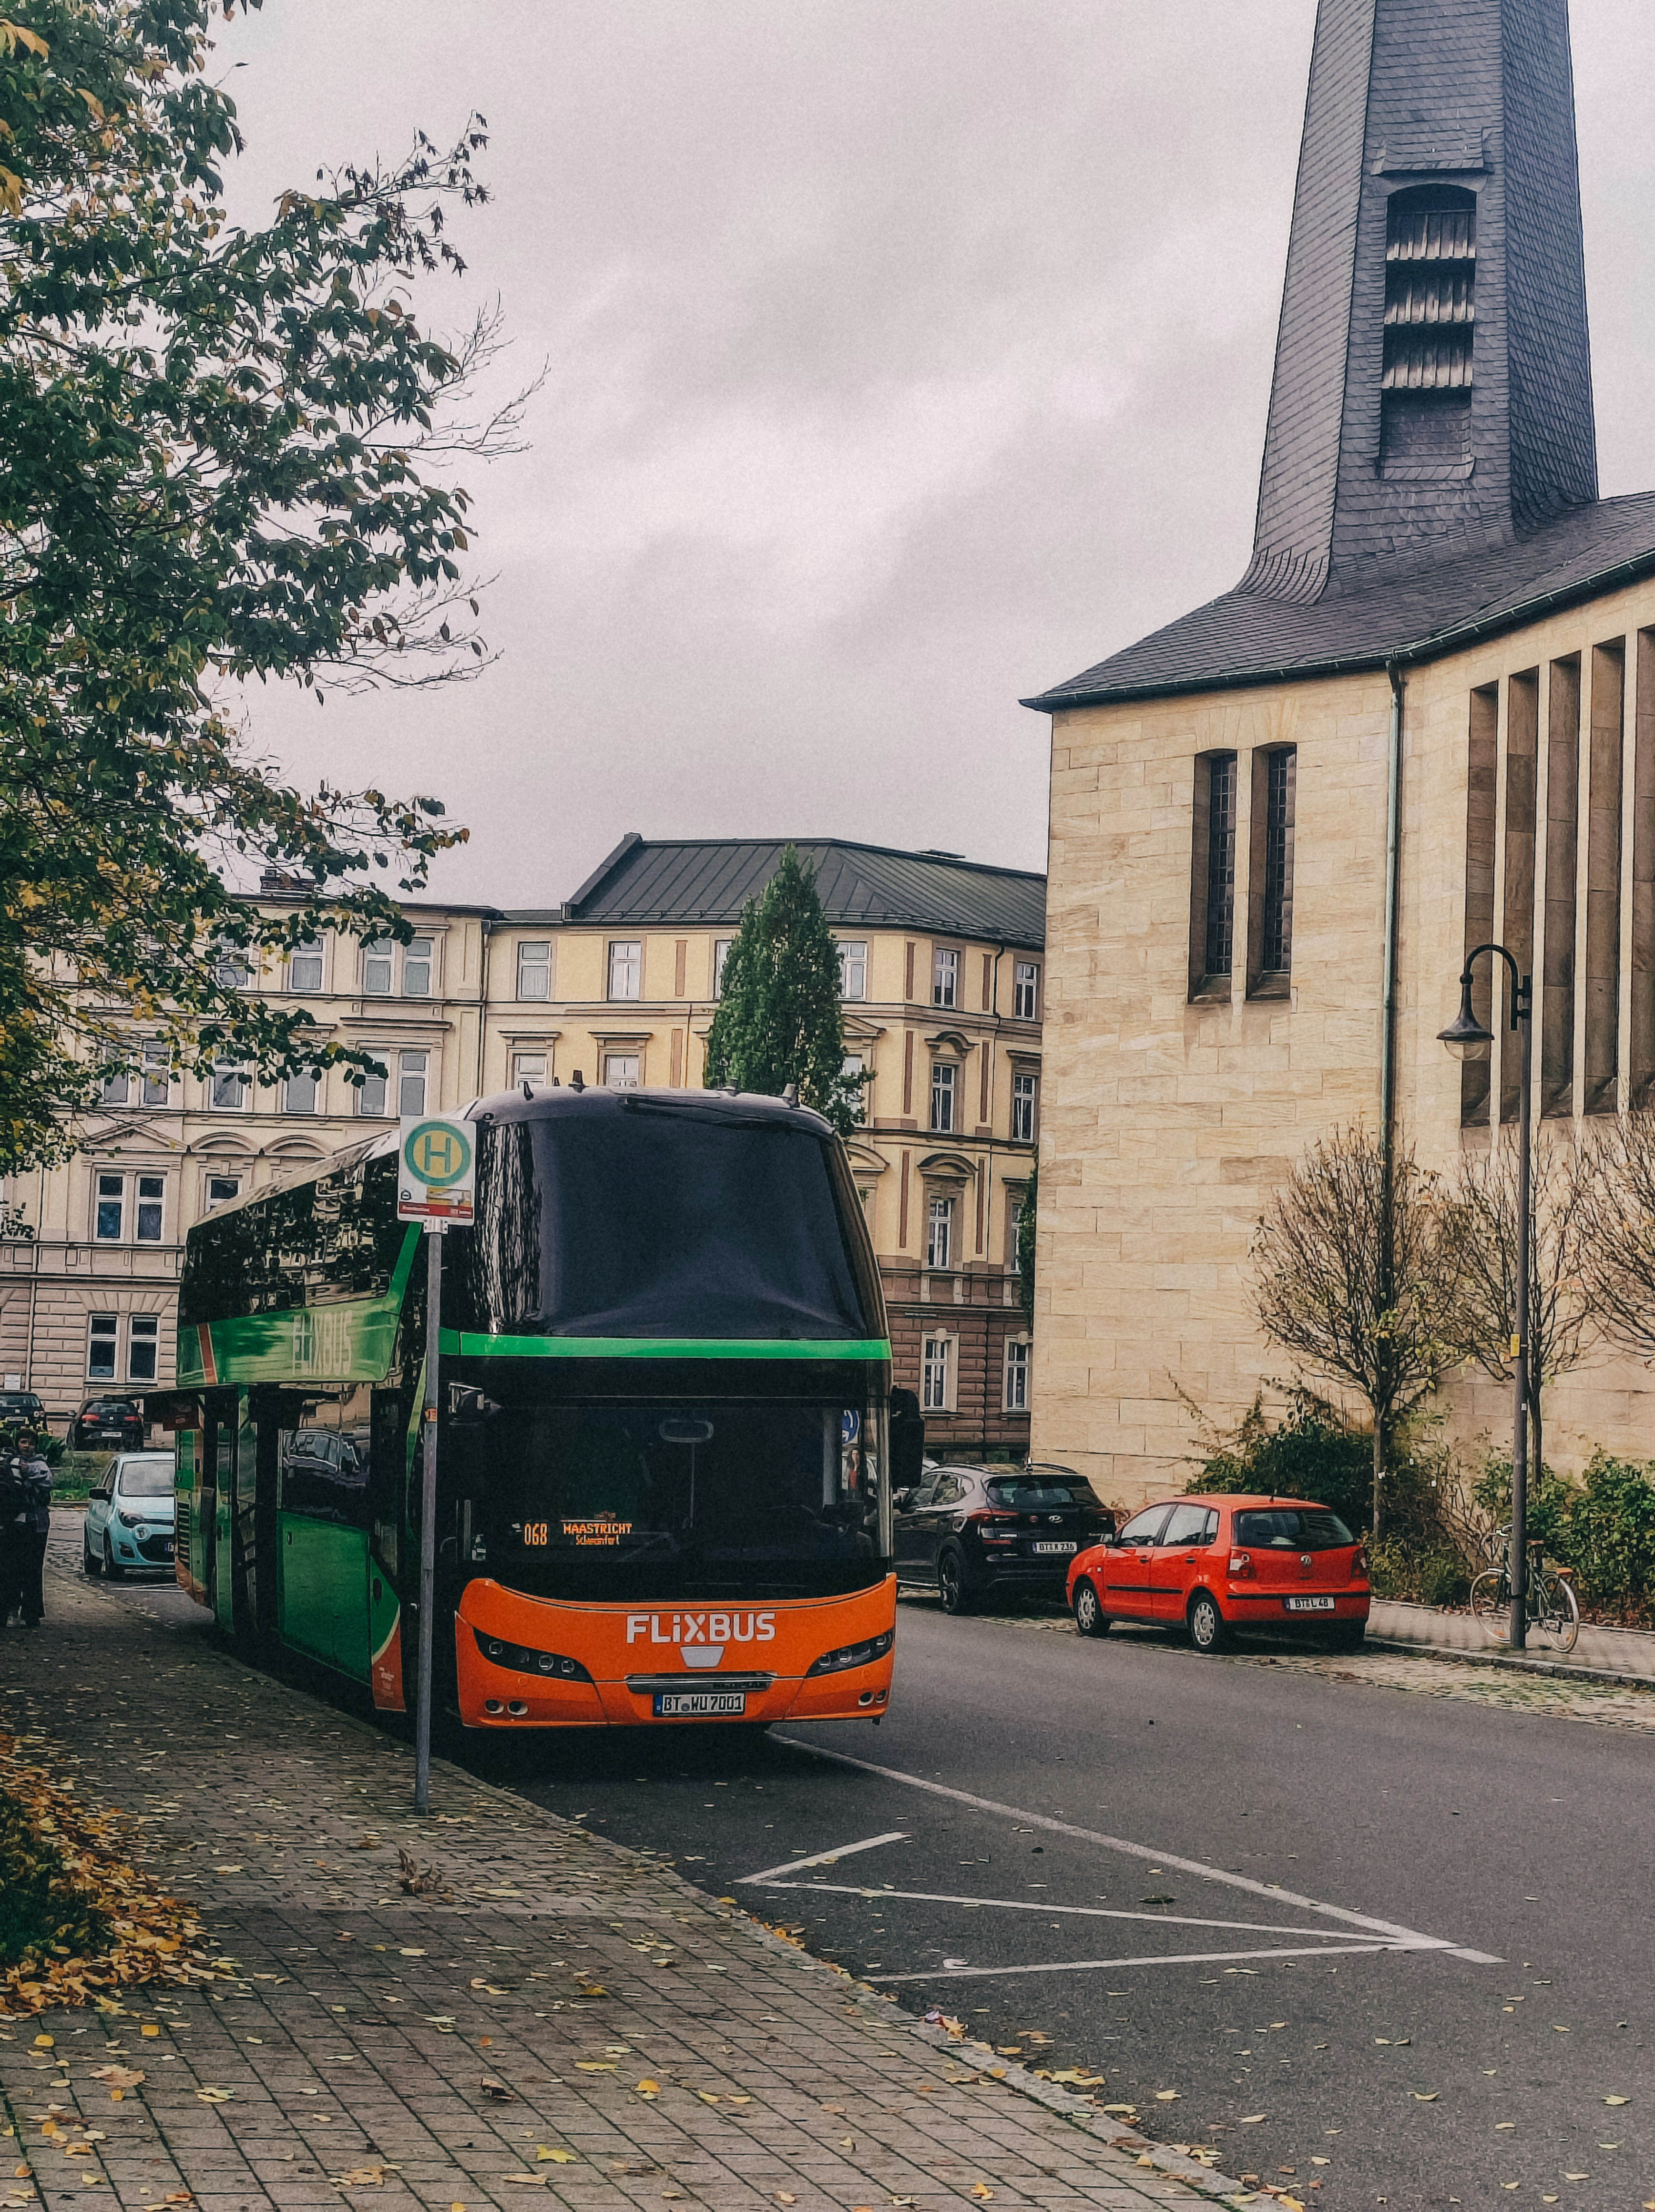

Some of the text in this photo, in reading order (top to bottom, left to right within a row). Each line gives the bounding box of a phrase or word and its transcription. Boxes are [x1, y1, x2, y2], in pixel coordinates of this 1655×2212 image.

[424, 1135, 451, 1173] H
[524, 1523, 633, 1546] 068 MAASTRICHT
[1295, 1599, 1305, 1608] BT
[626, 1612, 776, 1644] FLiXBUS
[664, 1695, 742, 1711] BT WU 7001
